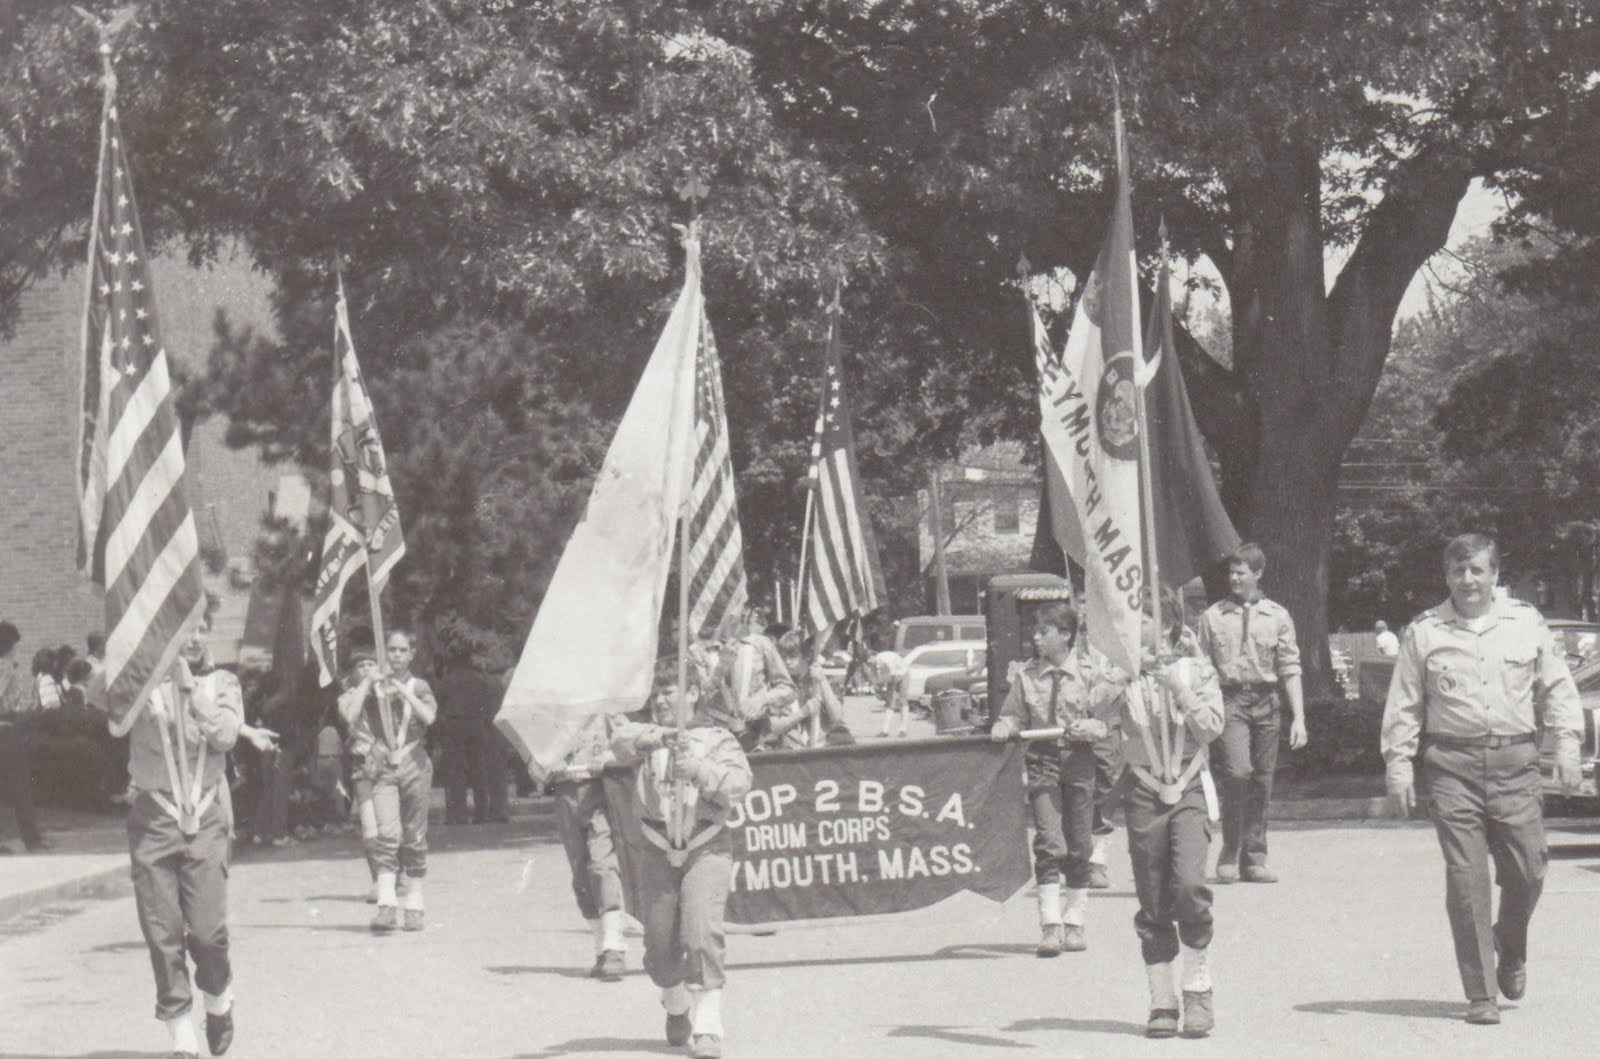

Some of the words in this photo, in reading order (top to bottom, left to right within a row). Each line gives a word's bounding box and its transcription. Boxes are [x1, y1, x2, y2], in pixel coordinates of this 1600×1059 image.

[814, 779, 841, 812] 2
[745, 822, 807, 852] DRUM
[818, 815, 891, 846] CORPS
[729, 852, 869, 893] YMOUTH,
[878, 843, 982, 881] MASS.
